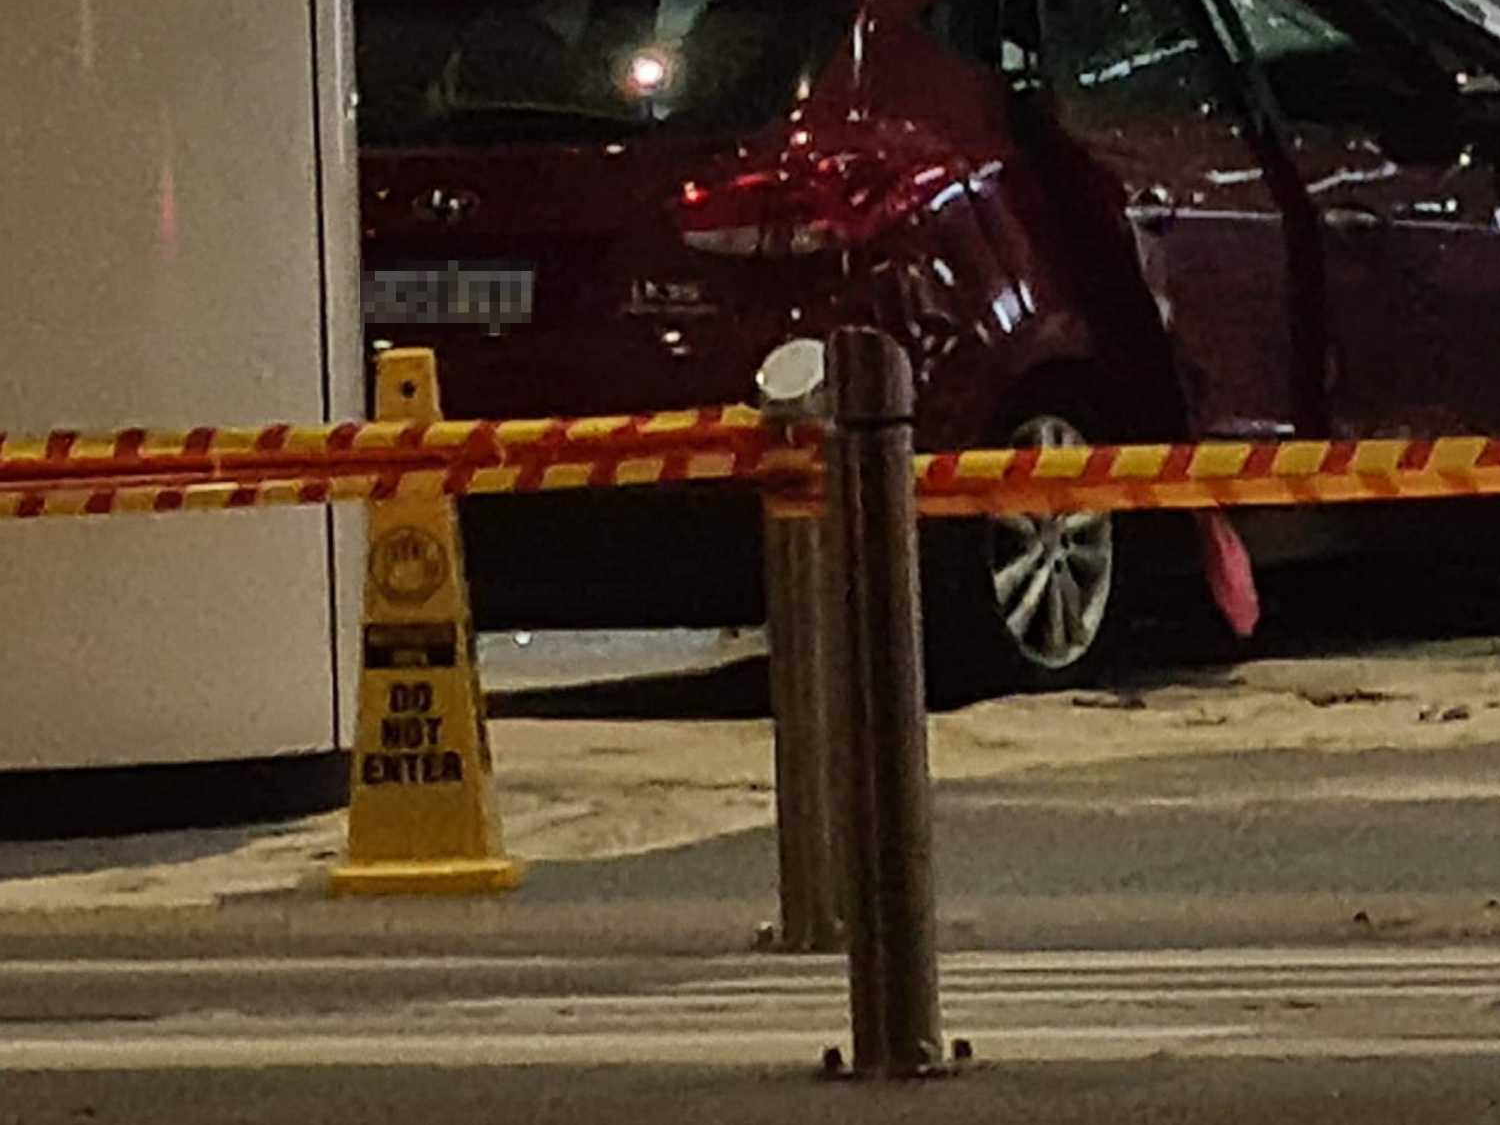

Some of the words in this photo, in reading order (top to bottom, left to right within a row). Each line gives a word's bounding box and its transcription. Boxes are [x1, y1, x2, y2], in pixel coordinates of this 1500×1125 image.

[389, 682, 432, 713] DO
[381, 717, 442, 748] NOT
[363, 750, 464, 784] ENTER
